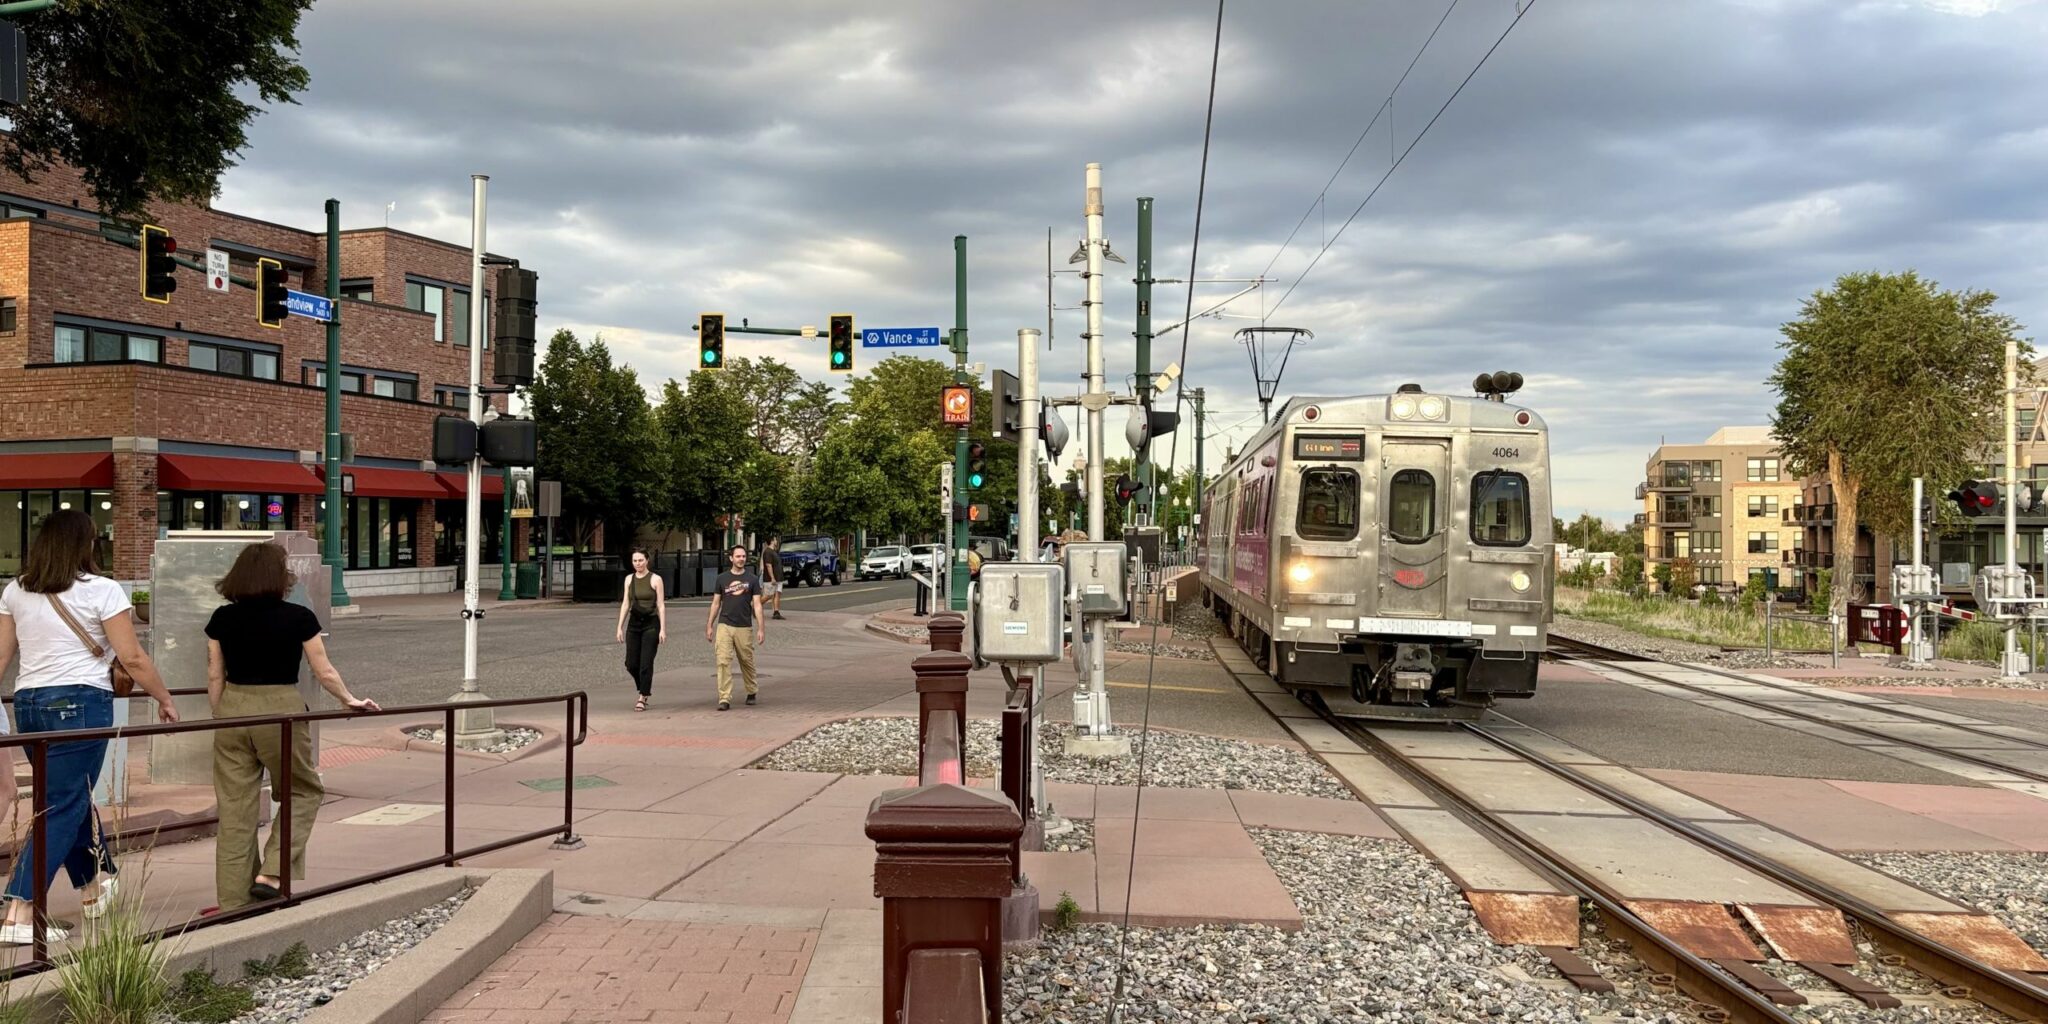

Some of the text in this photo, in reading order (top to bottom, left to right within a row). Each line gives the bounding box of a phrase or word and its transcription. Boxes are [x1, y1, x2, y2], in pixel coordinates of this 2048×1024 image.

[211, 261, 224, 270] TURN
[218, 270, 228, 278] RED
[286, 297, 314, 313] andview
[883, 331, 912, 344] Vance
[946, 414, 969, 422] TRAIN
[1492, 447, 1519, 458] 4064
